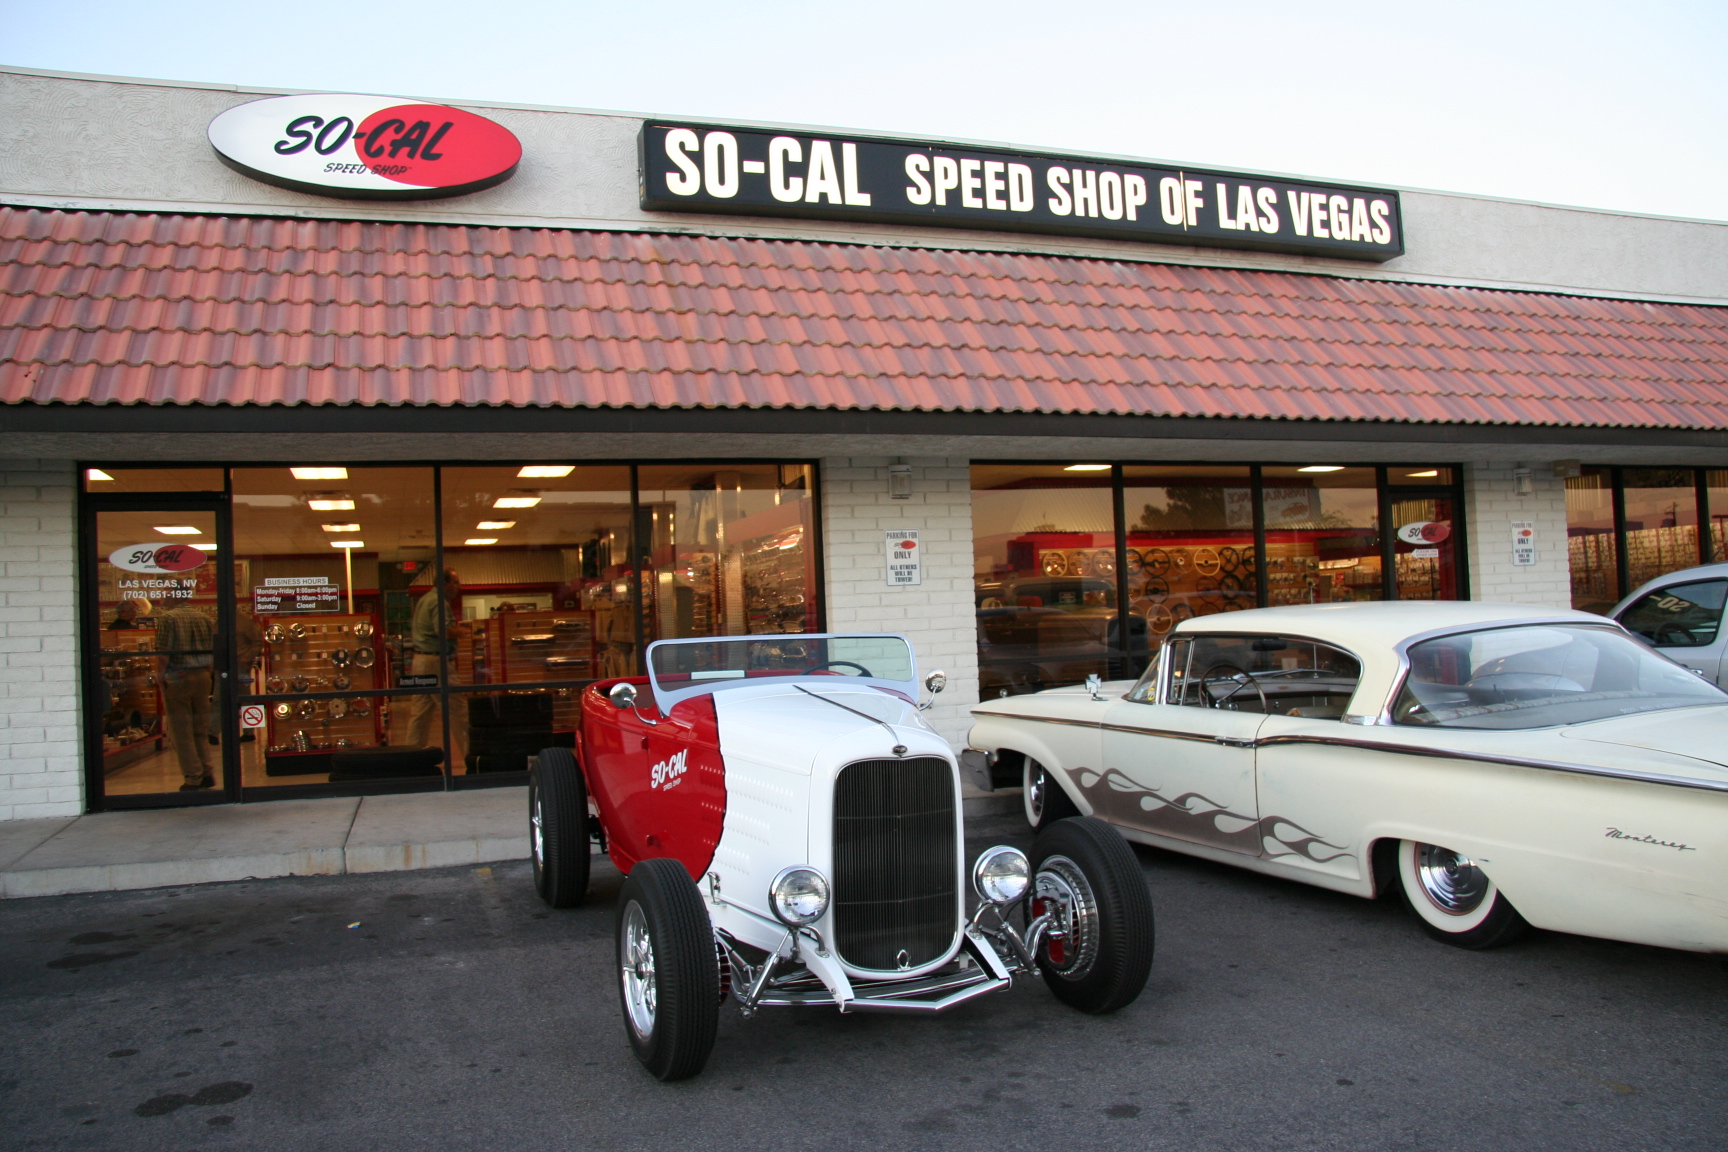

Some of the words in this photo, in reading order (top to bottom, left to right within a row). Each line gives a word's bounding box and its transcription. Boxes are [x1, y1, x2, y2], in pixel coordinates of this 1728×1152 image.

[274, 115, 454, 161] SO-CAL
[323, 162, 366, 175] SPEED
[371, 164, 409, 176] SHOP
[664, 128, 872, 207] SO-CAL
[904, 153, 1034, 213] SPEED
[1046, 166, 1147, 222] SHOP
[1159, 176, 1204, 227] OF
[1216, 182, 1280, 234] LAS
[1287, 190, 1392, 245] VEGAS
[128, 550, 184, 564] SO-CAL
[894, 551, 912, 559] ONLY
[119, 580, 140, 588] LAS
[142, 580, 180, 588] VEGAS,
[184, 580, 198, 588] NV
[123, 590, 148, 600] (702)
[150, 590, 193, 599] 651-1932
[651, 749, 688, 788] SO-CAL
[1605, 827, 1696, 851] Monterey
